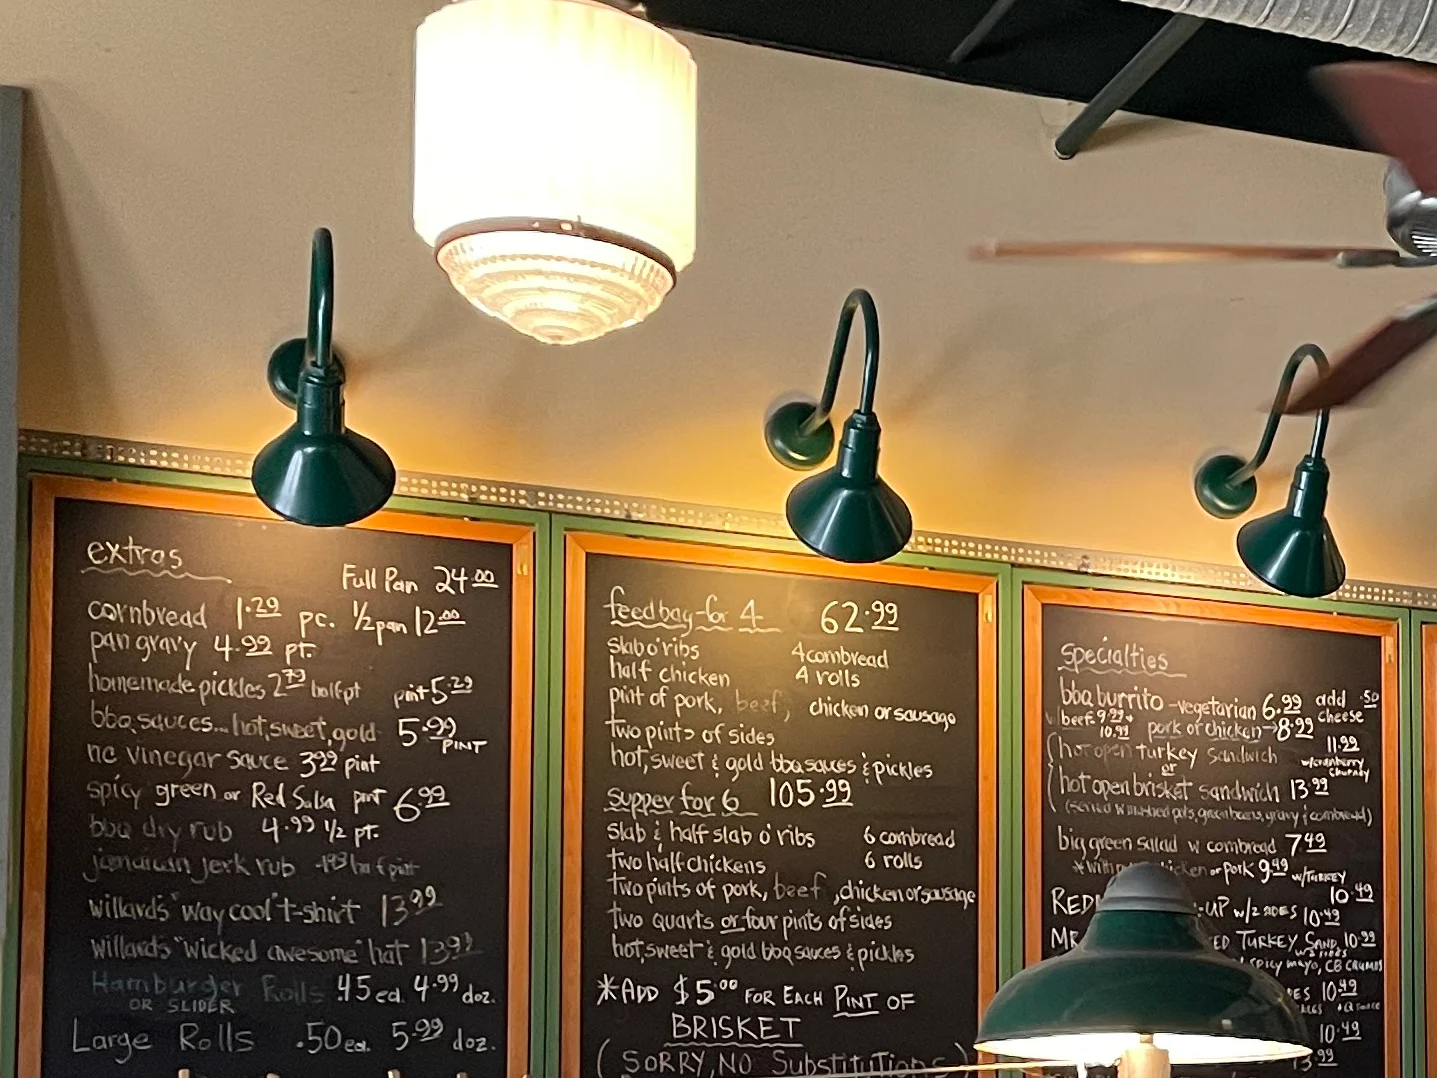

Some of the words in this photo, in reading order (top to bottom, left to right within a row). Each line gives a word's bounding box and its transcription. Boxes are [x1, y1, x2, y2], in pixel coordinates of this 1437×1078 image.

[342, 564, 378, 591] Full
[385, 567, 418, 593] Pan
[88, 600, 206, 629] cornbread
[88, 662, 195, 694] homemade
[200, 668, 266, 703] pickles
[610, 660, 653, 681] half
[659, 664, 730, 687] chicken
[817, 670, 860, 688] rolls
[1318, 709, 1364, 723] cheese
[729, 727, 775, 746] sides
[156, 774, 216, 802] green
[607, 787, 674, 818] supper
[680, 782, 715, 812] for
[1093, 775, 1131, 796] open
[1133, 772, 1192, 800] brisket
[1199, 783, 1279, 802] sandwich
[777, 823, 816, 847] ribs
[879, 830, 955, 848] cornbread
[652, 912, 715, 931] quarts
[744, 908, 778, 931] four
[782, 912, 822, 940] pints
[1236, 930, 1298, 952] TURKEY
[745, 988, 773, 1006] FOR
[834, 984, 879, 1011] PINT
[887, 990, 915, 1010] OF
[73, 1018, 152, 1063] Large
[179, 1023, 253, 1053] Rolls
[671, 1014, 802, 1041] BRISKET
